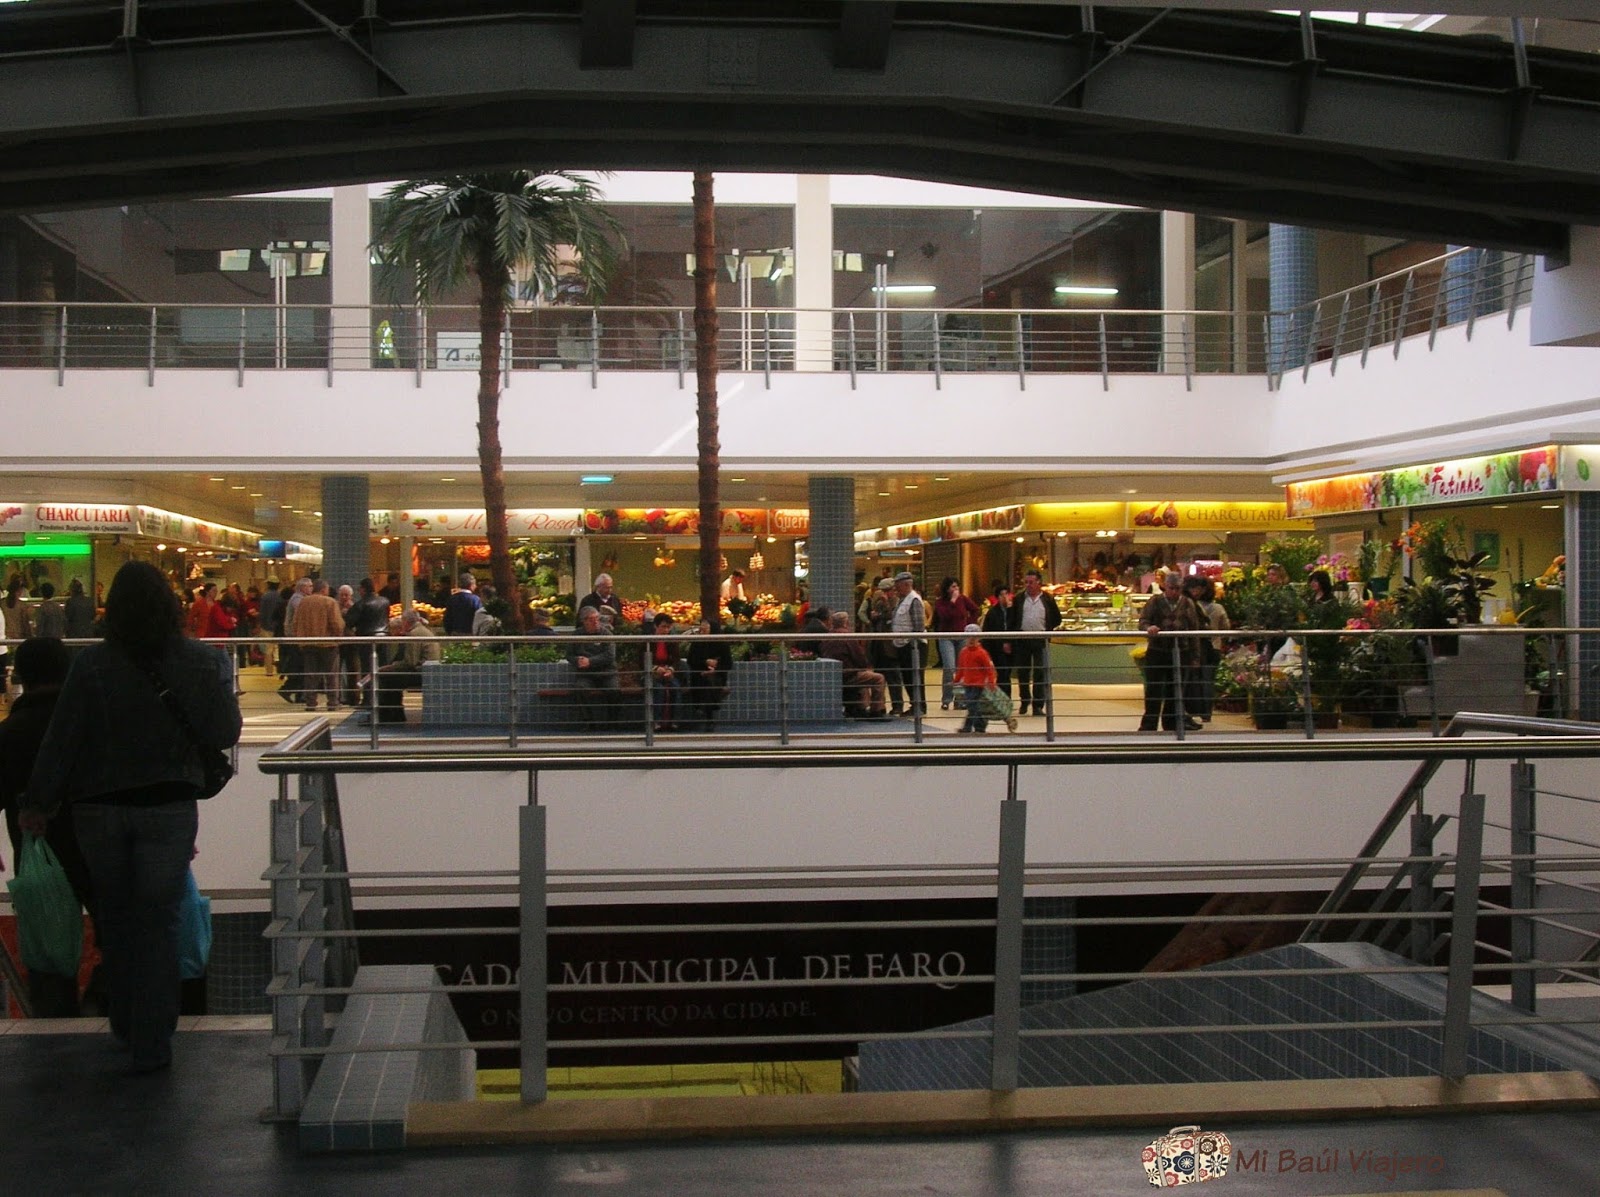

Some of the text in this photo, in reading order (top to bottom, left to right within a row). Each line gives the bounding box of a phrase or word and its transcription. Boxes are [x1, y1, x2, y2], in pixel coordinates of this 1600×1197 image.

[36, 507, 131, 523] CHARCUTARIA
[523, 513, 577, 531] Rosa
[561, 957, 784, 986] MUNICIPAL
[803, 954, 852, 981] DE
[579, 1004, 678, 1027] CENTRO
[686, 1004, 716, 1021] DA
